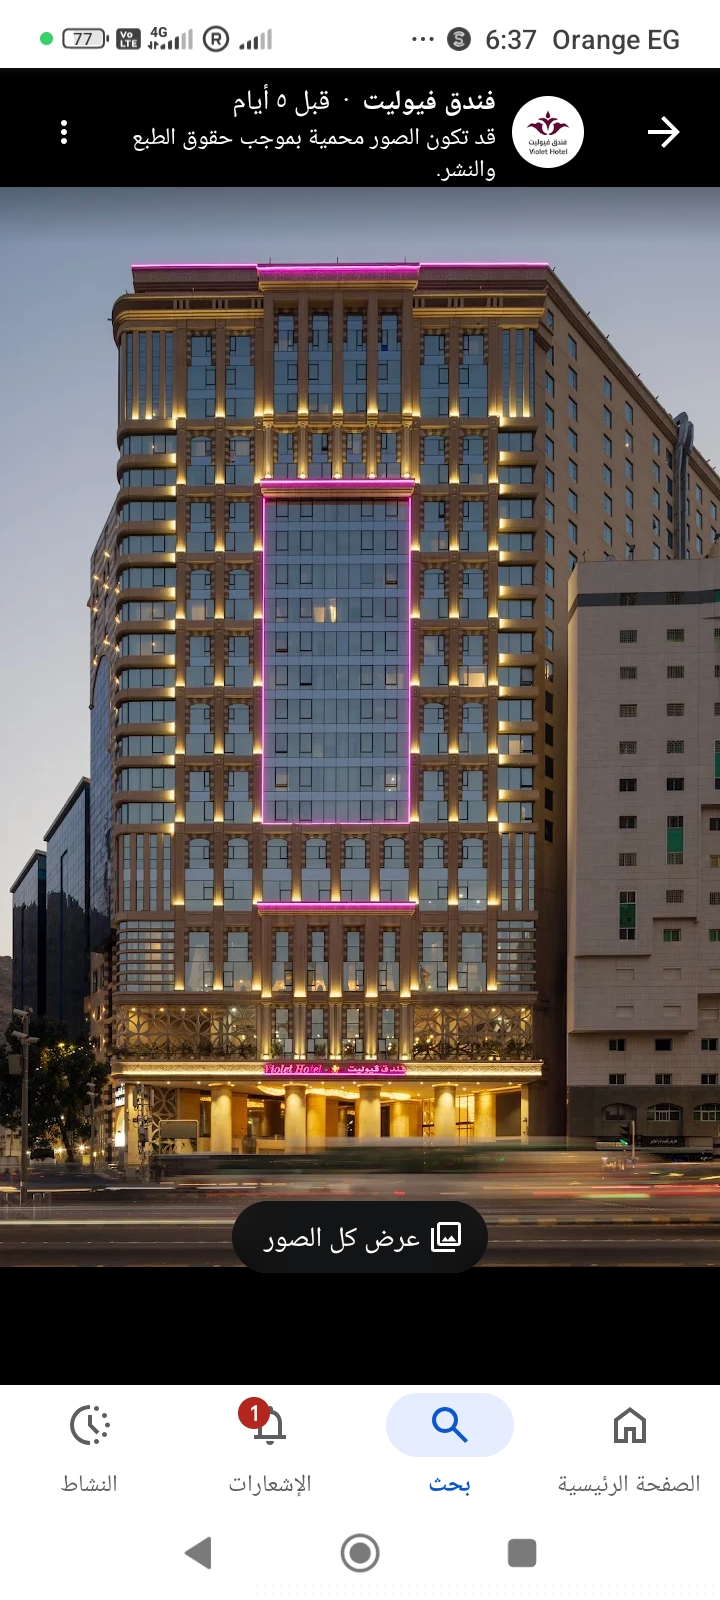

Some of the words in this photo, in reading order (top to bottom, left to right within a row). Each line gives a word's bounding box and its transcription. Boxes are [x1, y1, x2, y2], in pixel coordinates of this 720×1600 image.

[265, 1064, 294, 1073] Violet
[295, 1064, 323, 1073] Hotel
[347, 1064, 380, 1074] فيوليت
[380, 1064, 407, 1073] فندق
